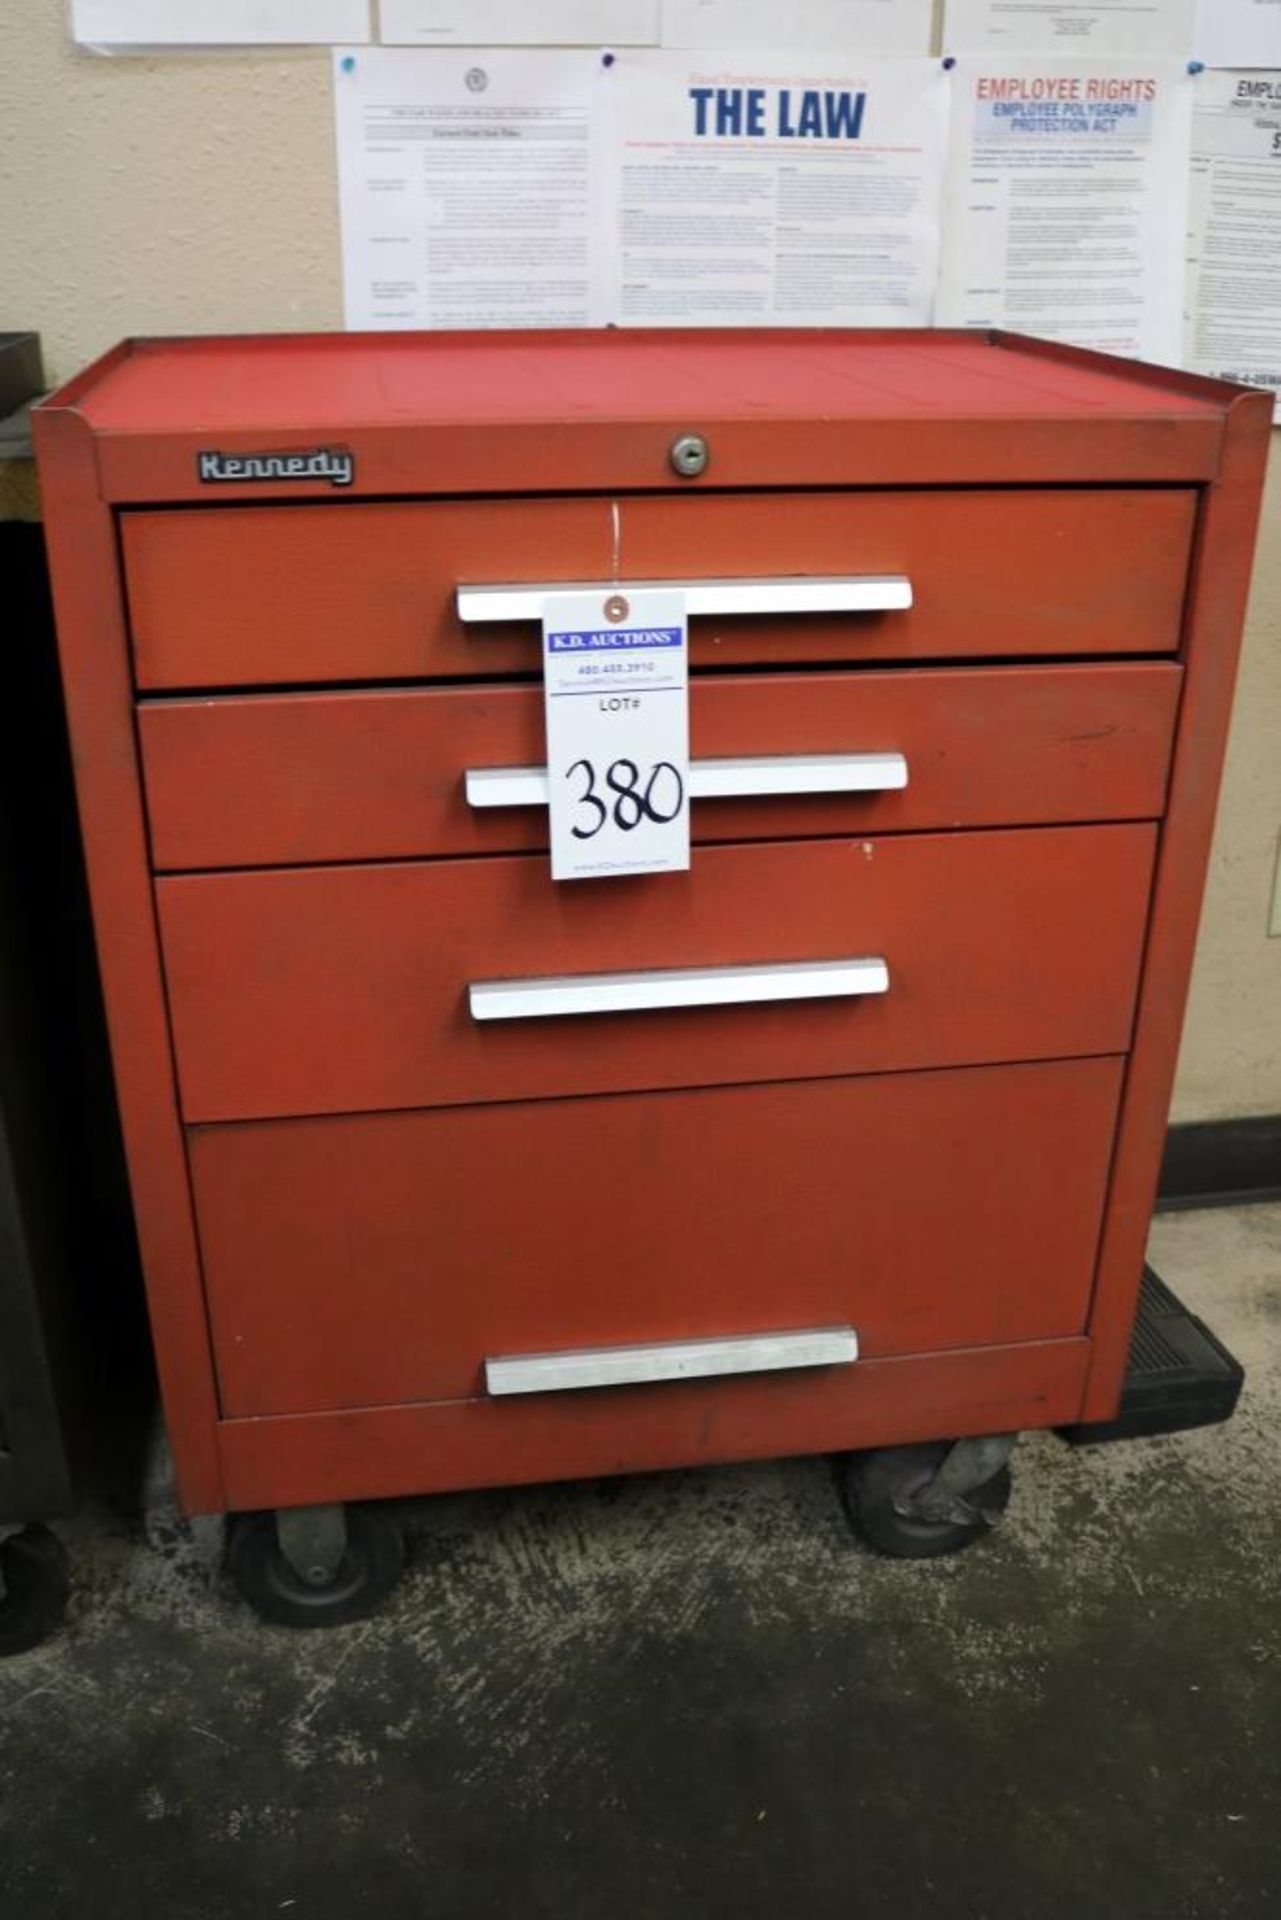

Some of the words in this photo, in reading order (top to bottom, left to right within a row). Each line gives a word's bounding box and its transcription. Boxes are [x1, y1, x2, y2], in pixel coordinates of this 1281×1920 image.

[976, 78, 1080, 100] EMPLOYEE
[1085, 79, 1156, 101] RIGHTS
[689, 88, 766, 136] THE
[778, 89, 866, 139] LAW
[993, 102, 1060, 117] EMPLOYEE
[1062, 103, 1138, 117] POLYGRAPH
[1010, 118, 1089, 133] PROTECTION
[1091, 119, 1117, 133] ACT
[201, 452, 352, 483] Kennedy
[553, 634, 588, 649] K.D.
[591, 630, 672, 647] AUCTIONS
[599, 697, 640, 711] LOT#
[565, 758, 683, 840] 380
